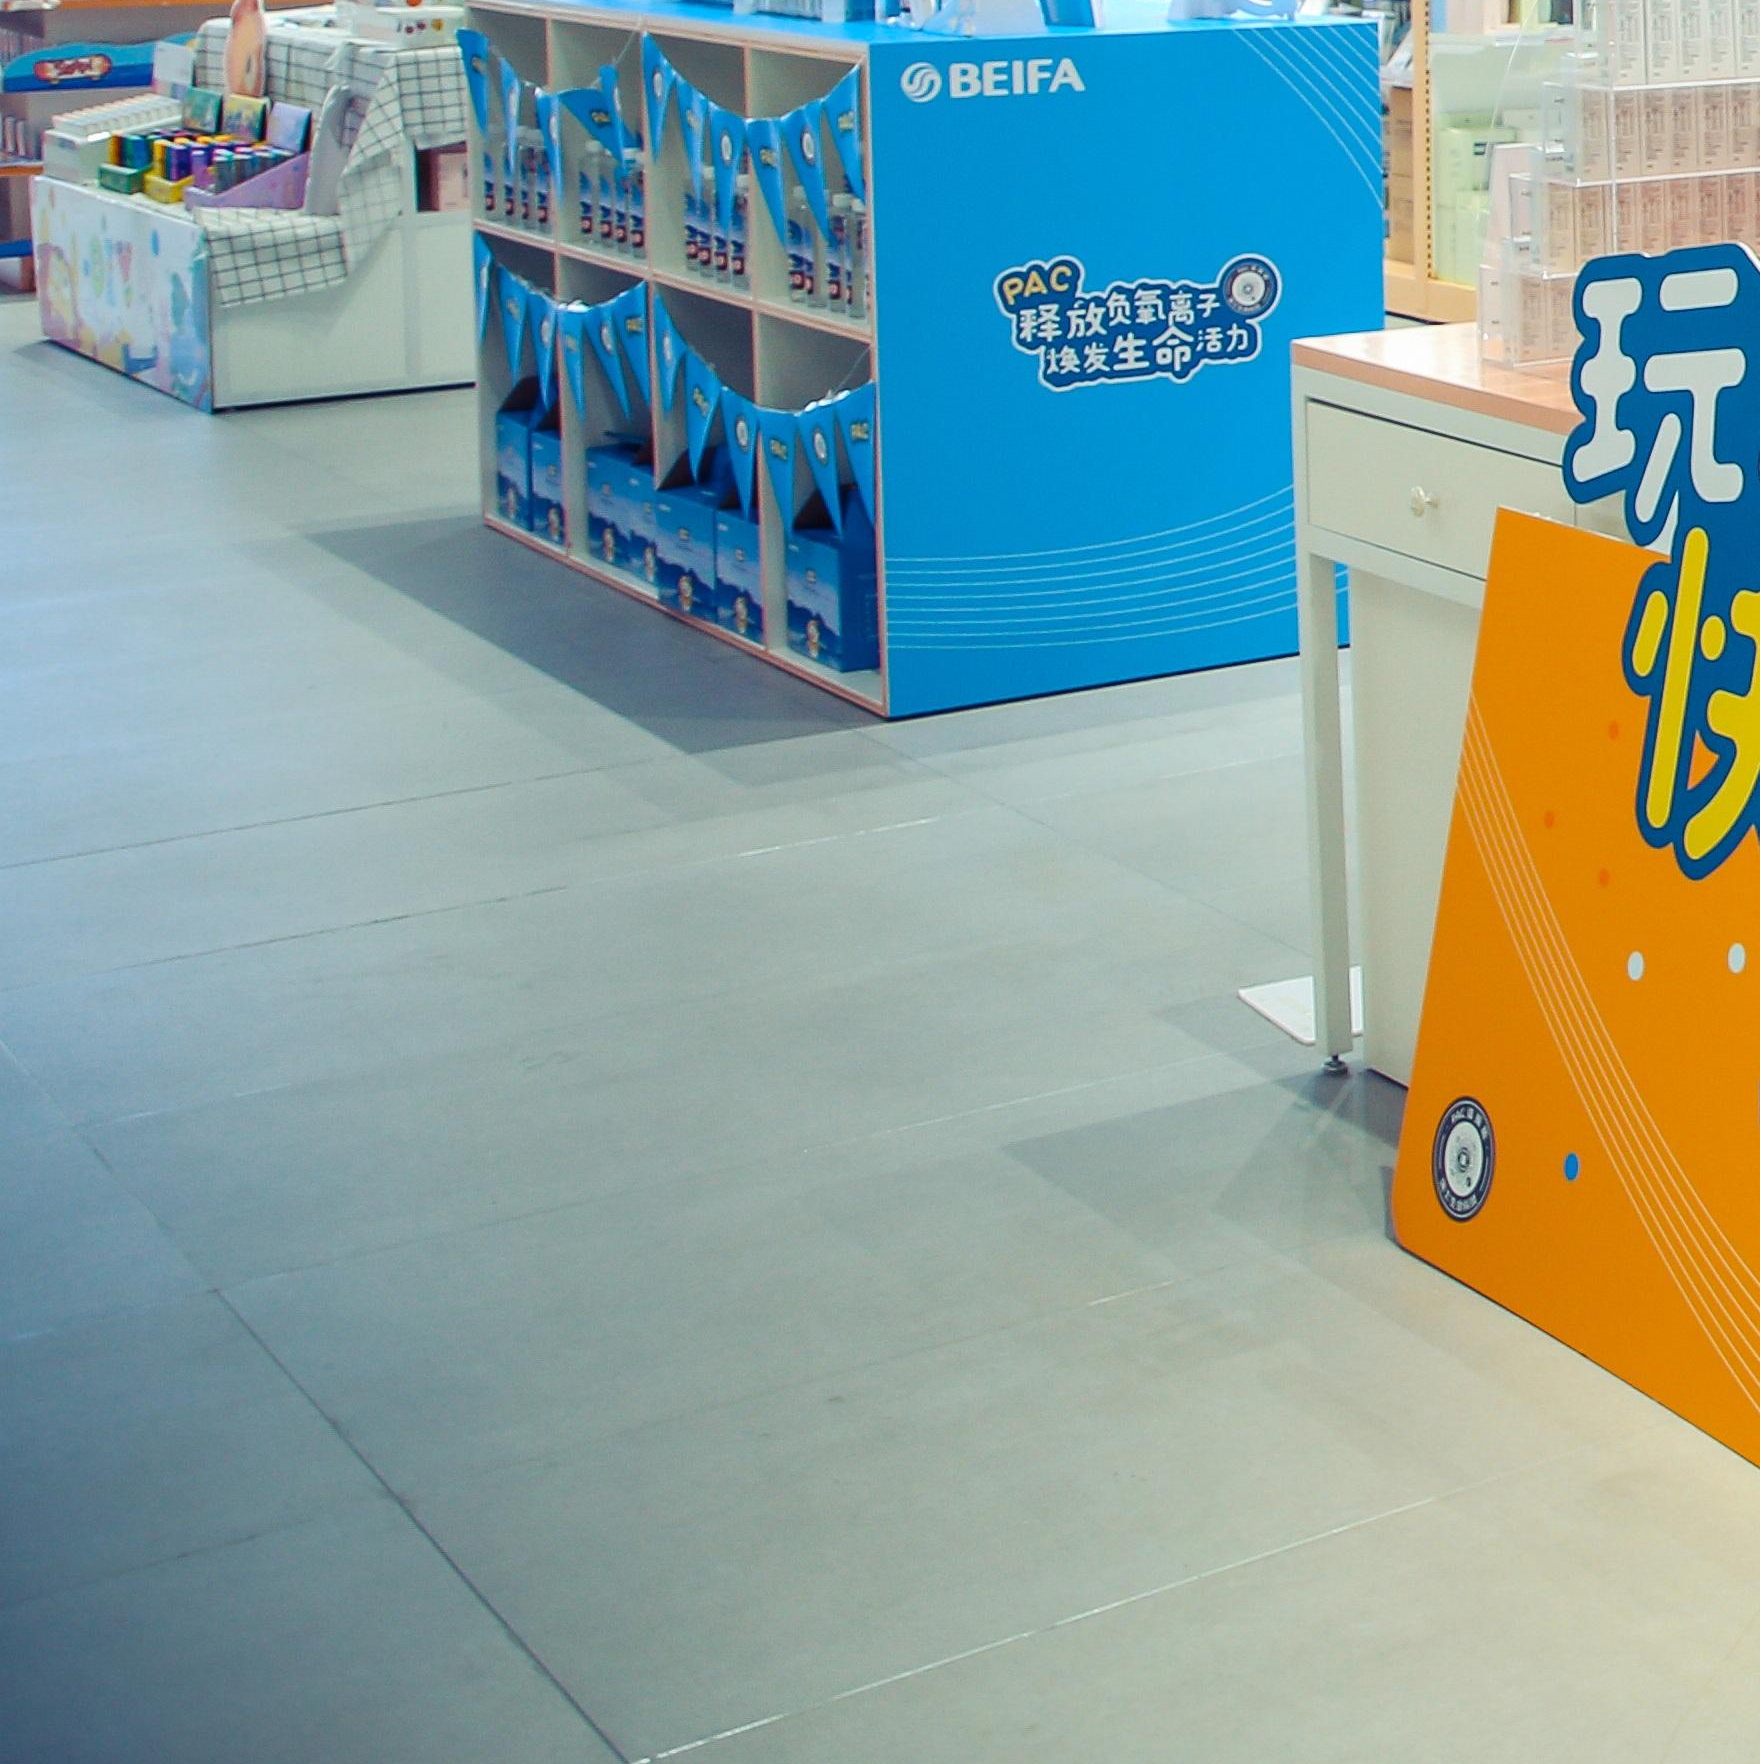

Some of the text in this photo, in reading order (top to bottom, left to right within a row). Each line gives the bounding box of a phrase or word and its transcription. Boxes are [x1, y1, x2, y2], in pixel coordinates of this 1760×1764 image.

[949, 58, 1086, 98] BEIFA
[1002, 267, 1073, 305] PAC
[1018, 289, 1221, 342] 释放负氧离子
[1046, 323, 1251, 376] 焕发生命活力
